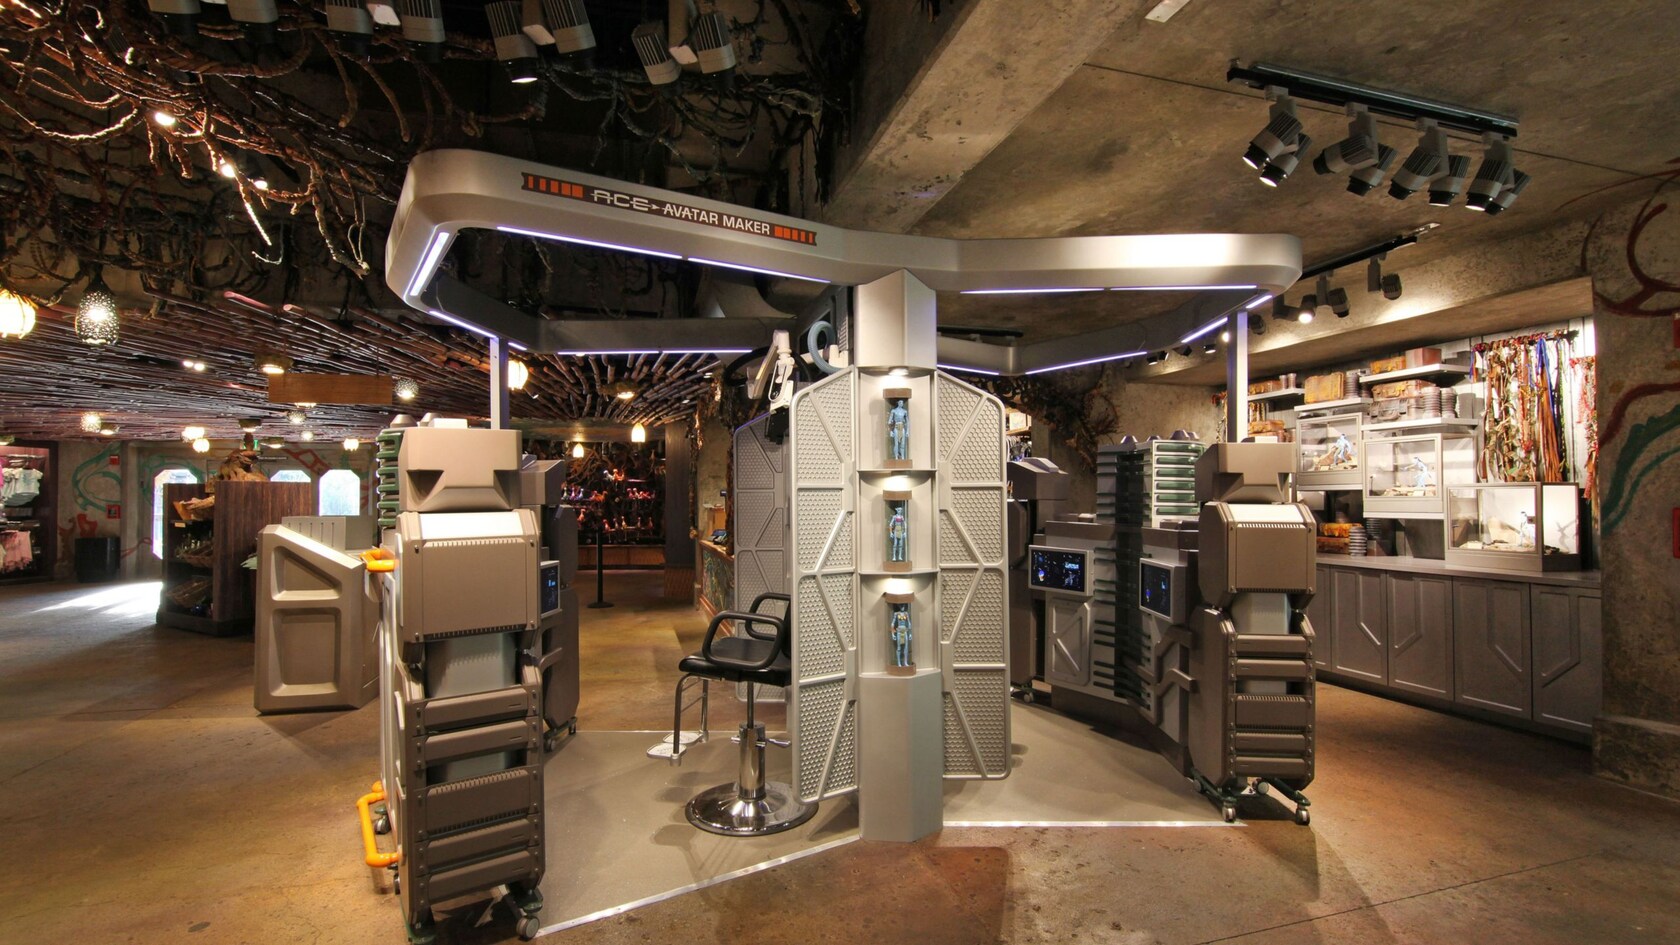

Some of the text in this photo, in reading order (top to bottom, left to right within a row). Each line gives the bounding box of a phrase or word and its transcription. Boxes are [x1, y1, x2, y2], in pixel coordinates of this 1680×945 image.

[591, 189, 770, 235] ACE AVATAR MAKER
